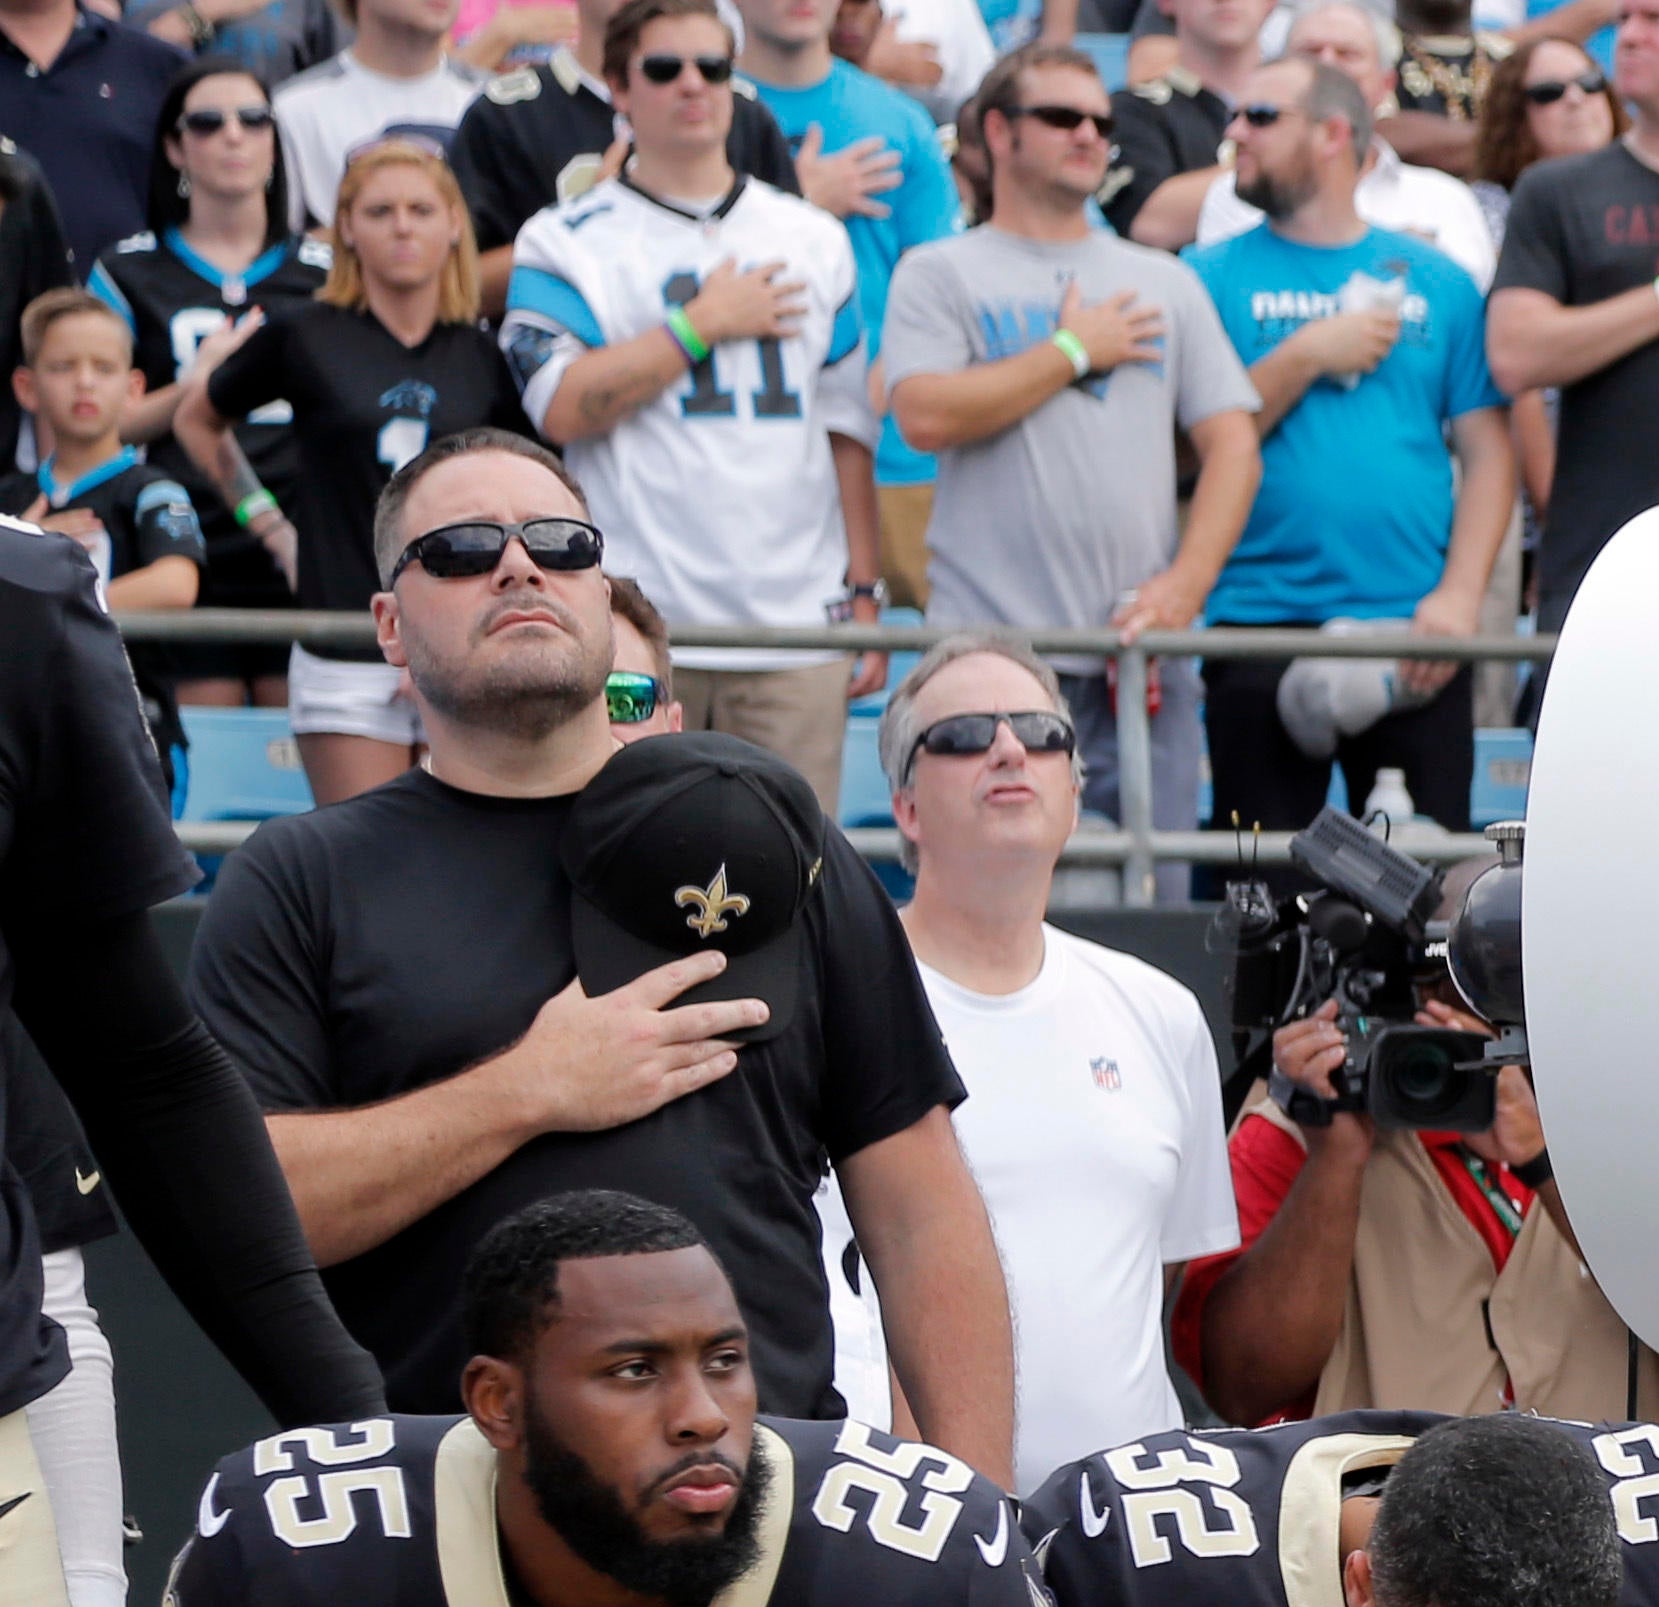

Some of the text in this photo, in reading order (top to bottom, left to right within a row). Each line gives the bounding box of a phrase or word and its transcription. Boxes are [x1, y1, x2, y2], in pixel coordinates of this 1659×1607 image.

[254, 1416, 412, 1549] 25
[811, 1419, 975, 1563] 25
[1104, 1436, 1260, 1569] 32
